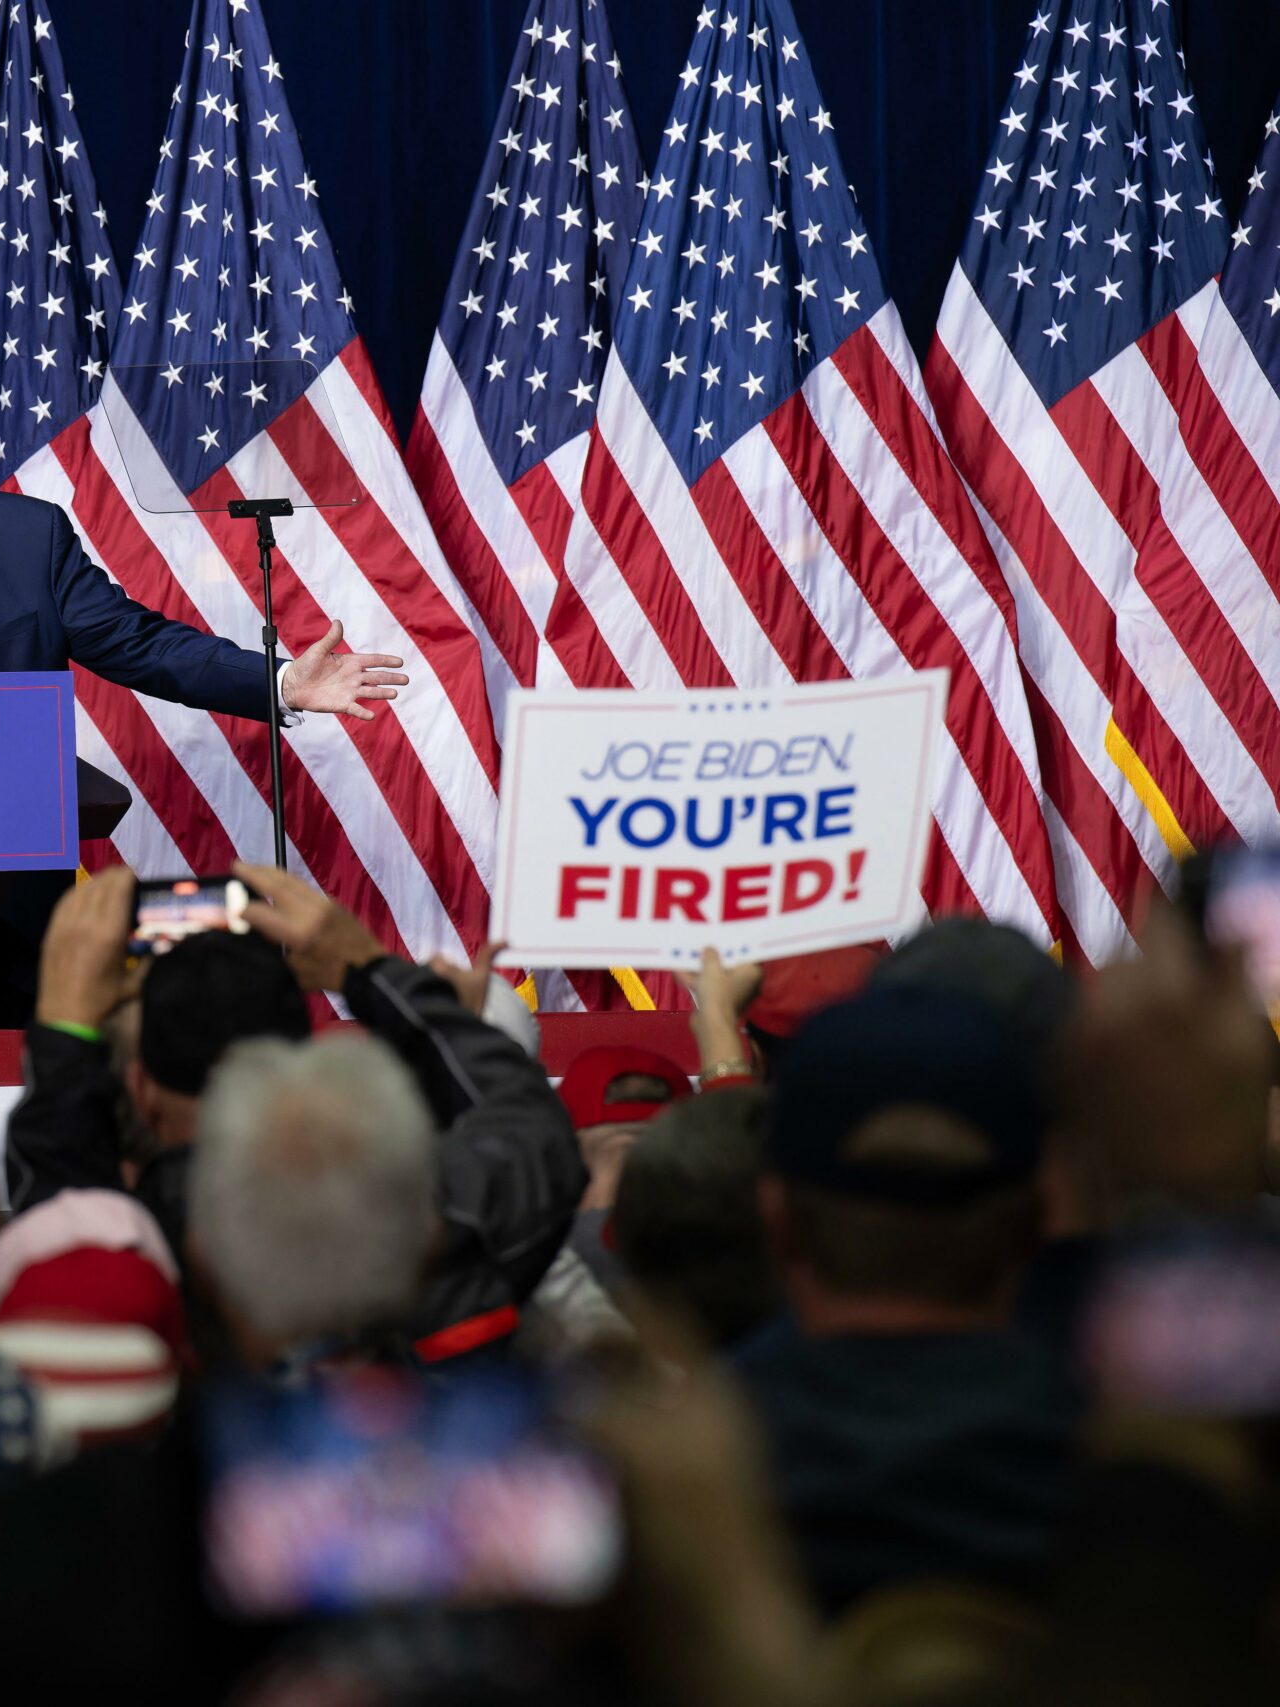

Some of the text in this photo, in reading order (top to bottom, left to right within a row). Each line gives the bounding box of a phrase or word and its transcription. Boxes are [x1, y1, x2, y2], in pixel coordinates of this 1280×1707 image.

[580, 741, 690, 783] JOE
[569, 785, 856, 851] YOU'RE
[556, 850, 867, 923] FIRED!
